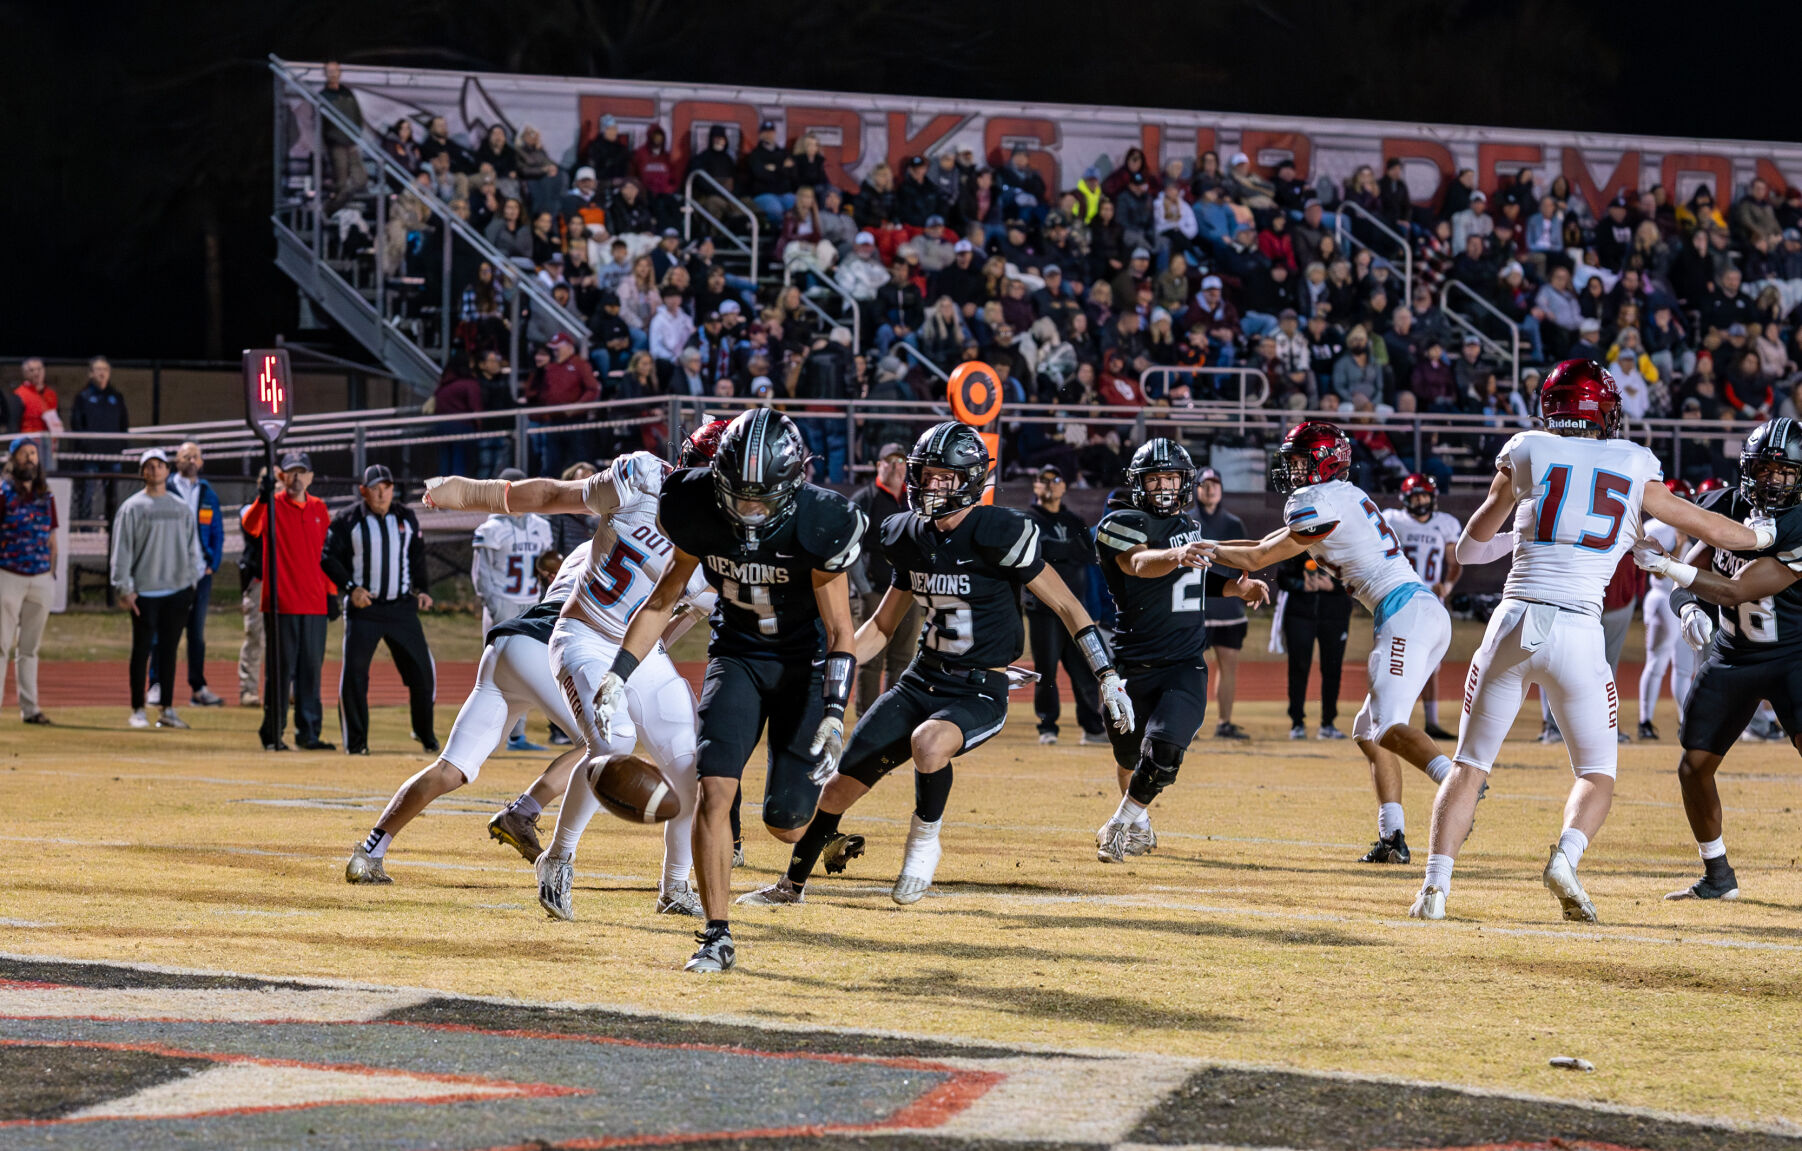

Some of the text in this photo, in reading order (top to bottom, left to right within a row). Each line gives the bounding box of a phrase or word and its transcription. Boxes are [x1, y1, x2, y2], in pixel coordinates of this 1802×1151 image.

[1548, 419, 1587, 430] Riddell
[1533, 463, 1633, 554] 15
[512, 542, 538, 553] DUTCH
[631, 525, 674, 558] DUT
[1406, 533, 1437, 545] DUTCH
[582, 534, 657, 625] 5
[705, 554, 790, 585] DEMONS
[1713, 547, 1752, 575] DEMO
[909, 570, 971, 595] DEMONS
[722, 578, 778, 635] 4
[1389, 636, 1407, 677] DUTCH
[562, 675, 583, 720] DUTCH
[1463, 663, 1480, 715] DUTCH
[1605, 681, 1617, 729] DUTCH
